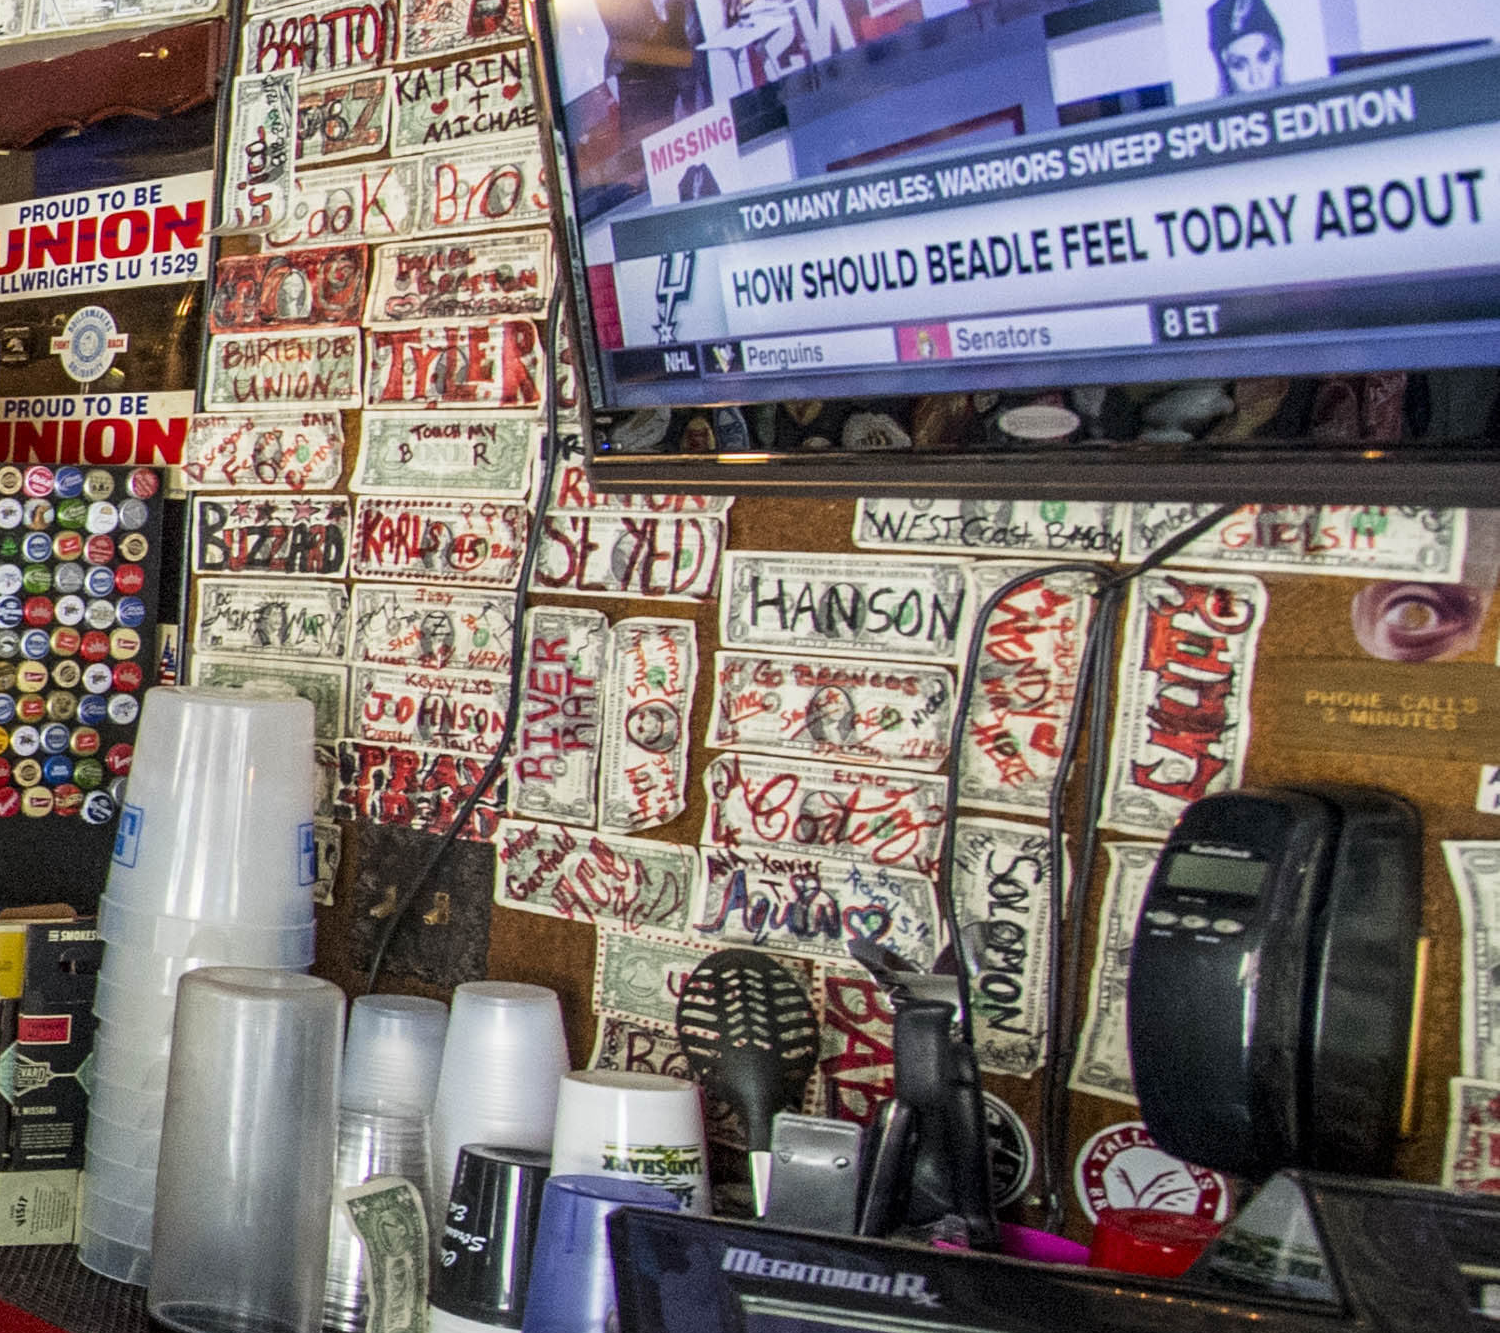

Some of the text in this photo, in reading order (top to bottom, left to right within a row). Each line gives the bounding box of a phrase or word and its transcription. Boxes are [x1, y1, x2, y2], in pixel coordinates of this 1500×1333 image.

[394, 51, 522, 106] KATRIN
[649, 115, 734, 176] MISSING
[738, 85, 1414, 232] TOO MANY ANGLES: WARRIORS SWEEP SPURS EDITION
[19, 183, 163, 224] PROUD TO BE
[732, 168, 1485, 308] HOW SHOULD BEADLE FEEL TODAY ABOUT
[114, 256, 143, 284] LU
[148, 251, 200, 278] 1529
[956, 319, 1051, 352] Senators
[1163, 304, 1220, 337] 8 ET
[370, 320, 543, 408] TYLER
[664, 351, 695, 373] NHL
[747, 341, 824, 372] Penguins
[3, 394, 150, 421] PROUD TO BE
[410, 423, 497, 442] TOUCH MY
[201, 500, 346, 573] BUZZARD
[748, 572, 967, 642] HANSON
[986, 579, 1062, 718] WENDY
[791, 662, 921, 697] BRONCOS
[1303, 689, 1480, 714] PHONE CALLS
[517, 635, 568, 785] RIVER
[562, 672, 597, 753] RAT
[1350, 709, 1459, 731] MINUTES
[722, 1247, 893, 1295] MEGATOUCH
